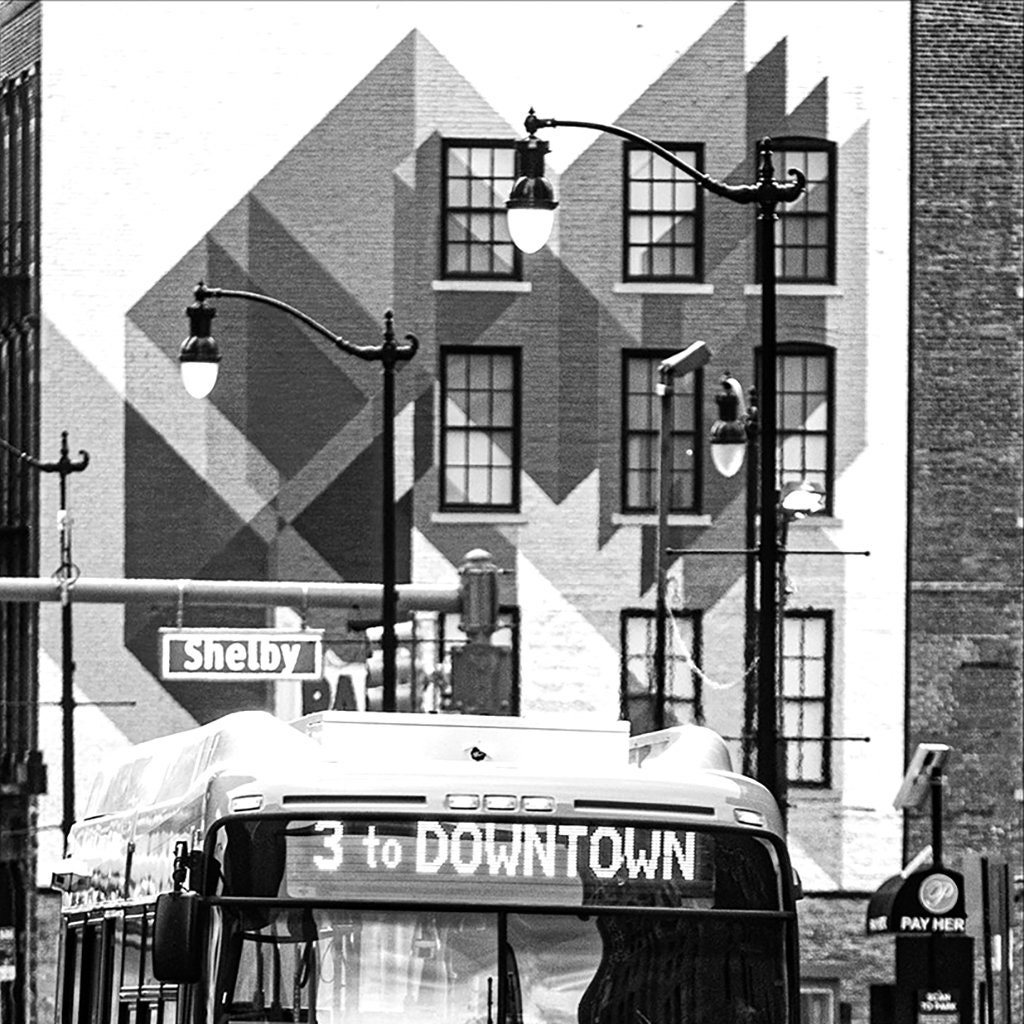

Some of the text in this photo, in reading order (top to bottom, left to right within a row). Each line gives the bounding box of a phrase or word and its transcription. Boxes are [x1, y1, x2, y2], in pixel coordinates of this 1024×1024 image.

[183, 638, 301, 673] Shelby
[313, 820, 696, 881] 3 to DOWNTOWN
[900, 916, 930, 931] PAY
